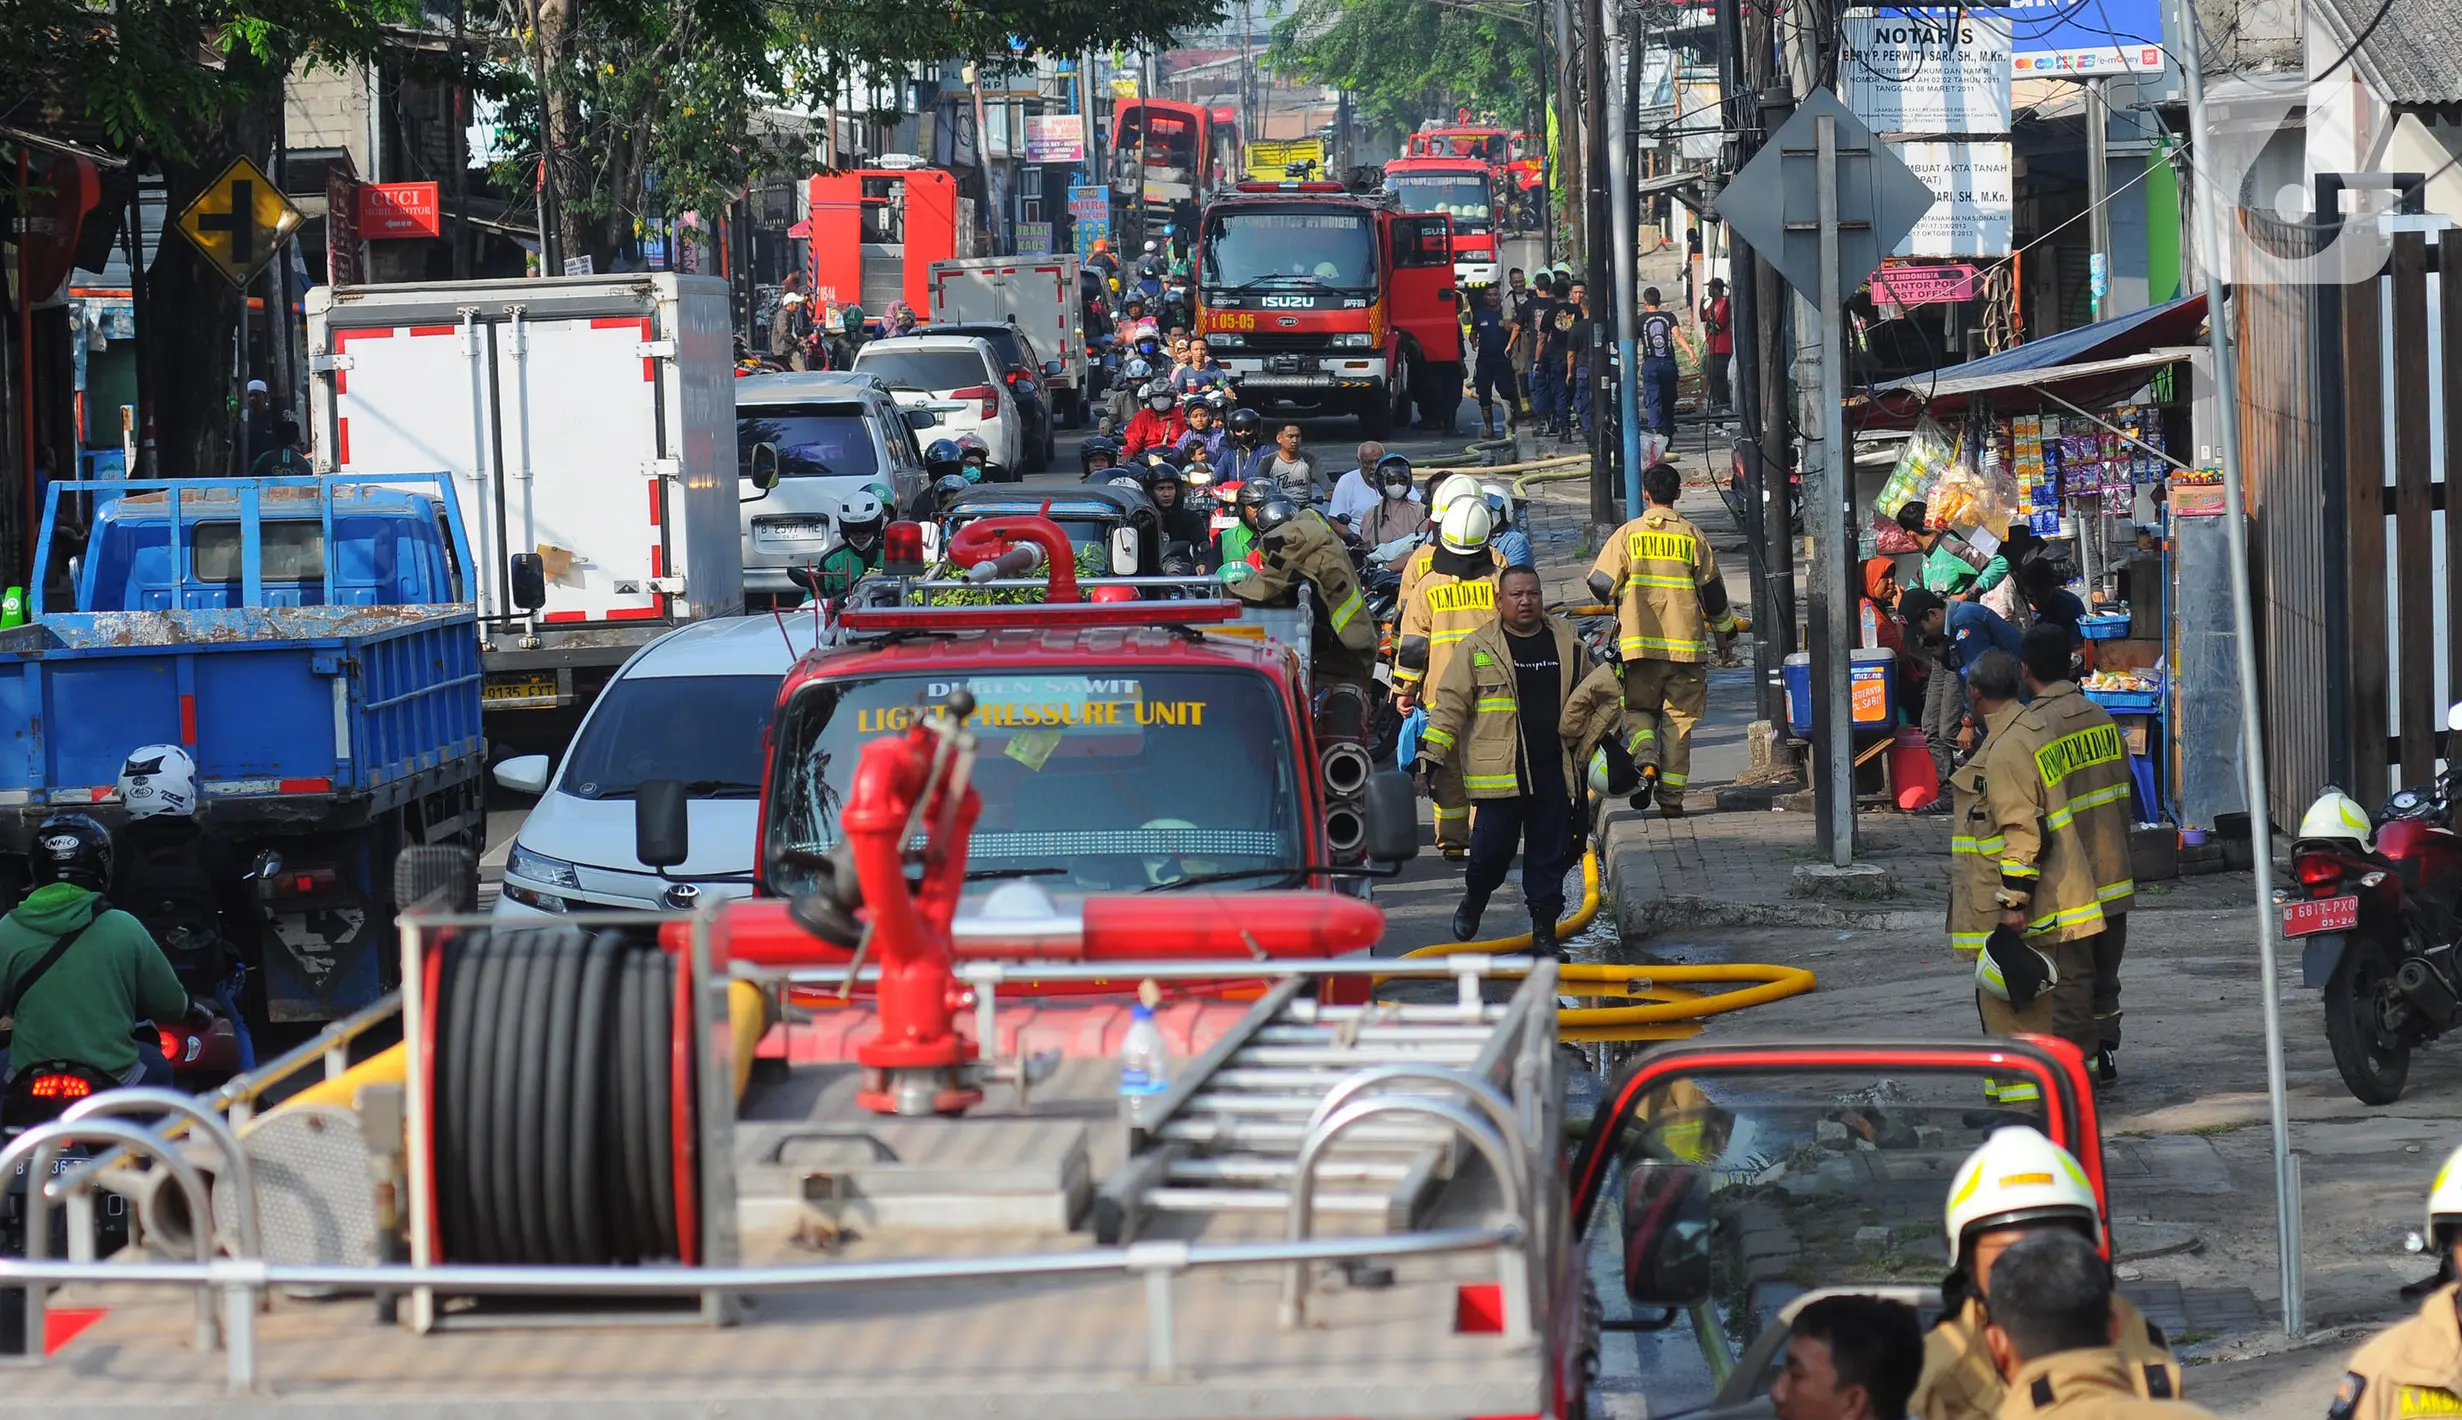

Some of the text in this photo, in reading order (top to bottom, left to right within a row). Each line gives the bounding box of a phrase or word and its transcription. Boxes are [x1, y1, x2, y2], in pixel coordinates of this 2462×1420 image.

[1882, 51, 1926, 62] PERWITA
[1929, 51, 1955, 64] SARI,
[1957, 51, 1977, 64] SH.,
[1979, 51, 2006, 62] M.Kn.
[1907, 164, 2007, 172] MBUAT AKTA TANAH
[1920, 176, 1942, 185] PAT)
[371, 191, 420, 206] CUCI
[1934, 192, 2008, 204] ARI, SH., M.Kn.
[399, 206, 432, 216] MOTOR
[1069, 201, 1106, 211] MITRA
[1018, 240, 1046, 251] KAOS
[1896, 272, 1940, 281] INDONESIA
[1886, 280, 1956, 290] KANTOR POS
[1917, 289, 1957, 298] OFFICE
[1261, 296, 1315, 308] ISUZU
[1219, 313, 1255, 329] 05-05
[761, 523, 768, 535] B
[774, 523, 799, 534] 2597
[1632, 536, 1692, 561] PEMADAM
[1045, 679, 1140, 694] SAWIT
[857, 701, 1206, 732] LIGT PRESSURE UNIT
[2285, 908, 2293, 921] B
